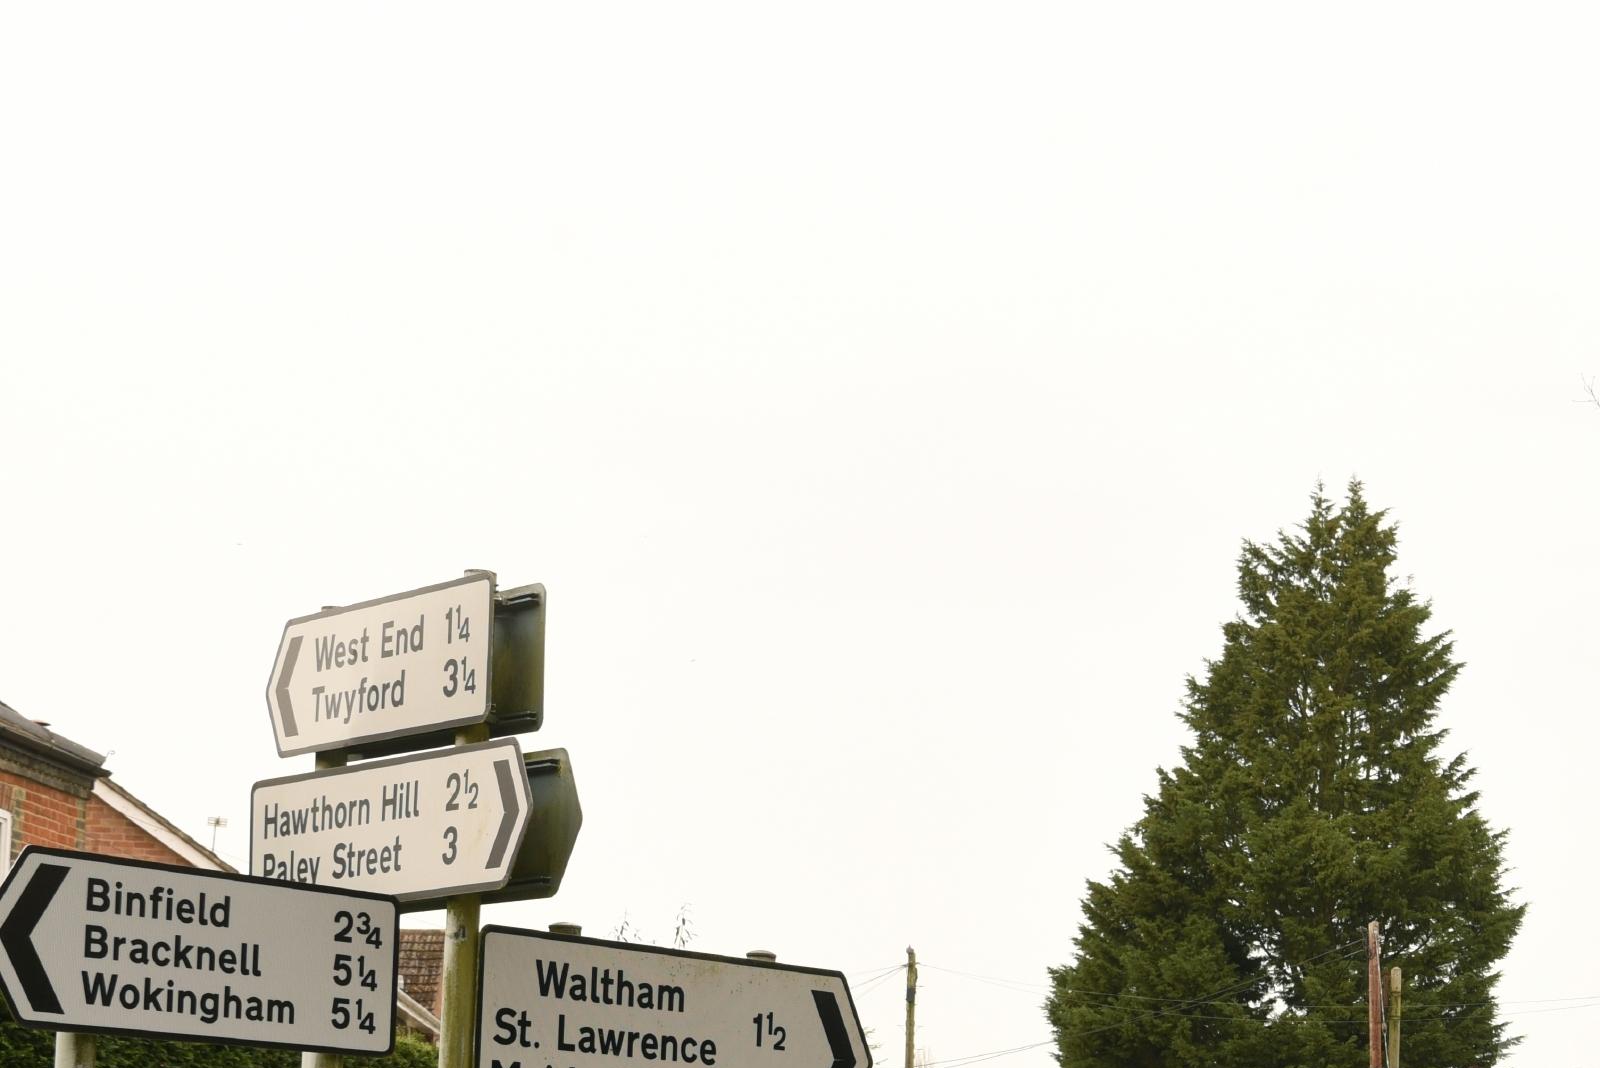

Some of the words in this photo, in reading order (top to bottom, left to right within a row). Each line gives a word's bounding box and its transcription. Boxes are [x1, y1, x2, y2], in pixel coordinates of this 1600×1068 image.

[315, 627, 369, 672] West
[381, 614, 425, 658] End
[312, 669, 406, 724] Twyford
[264, 795, 370, 839] Hawthorn
[381, 780, 419, 821] Hill
[263, 850, 320, 884] Paley
[332, 835, 402, 879] Street
[442, 826, 458, 865] 3
[86, 877, 231, 928] Binfield
[84, 924, 261, 976] Bracknell
[81, 970, 295, 1024] Wokingham
[535, 959, 685, 1012] Waltham
[493, 1007, 539, 1048] St.
[557, 1014, 717, 1066] Lawrence
